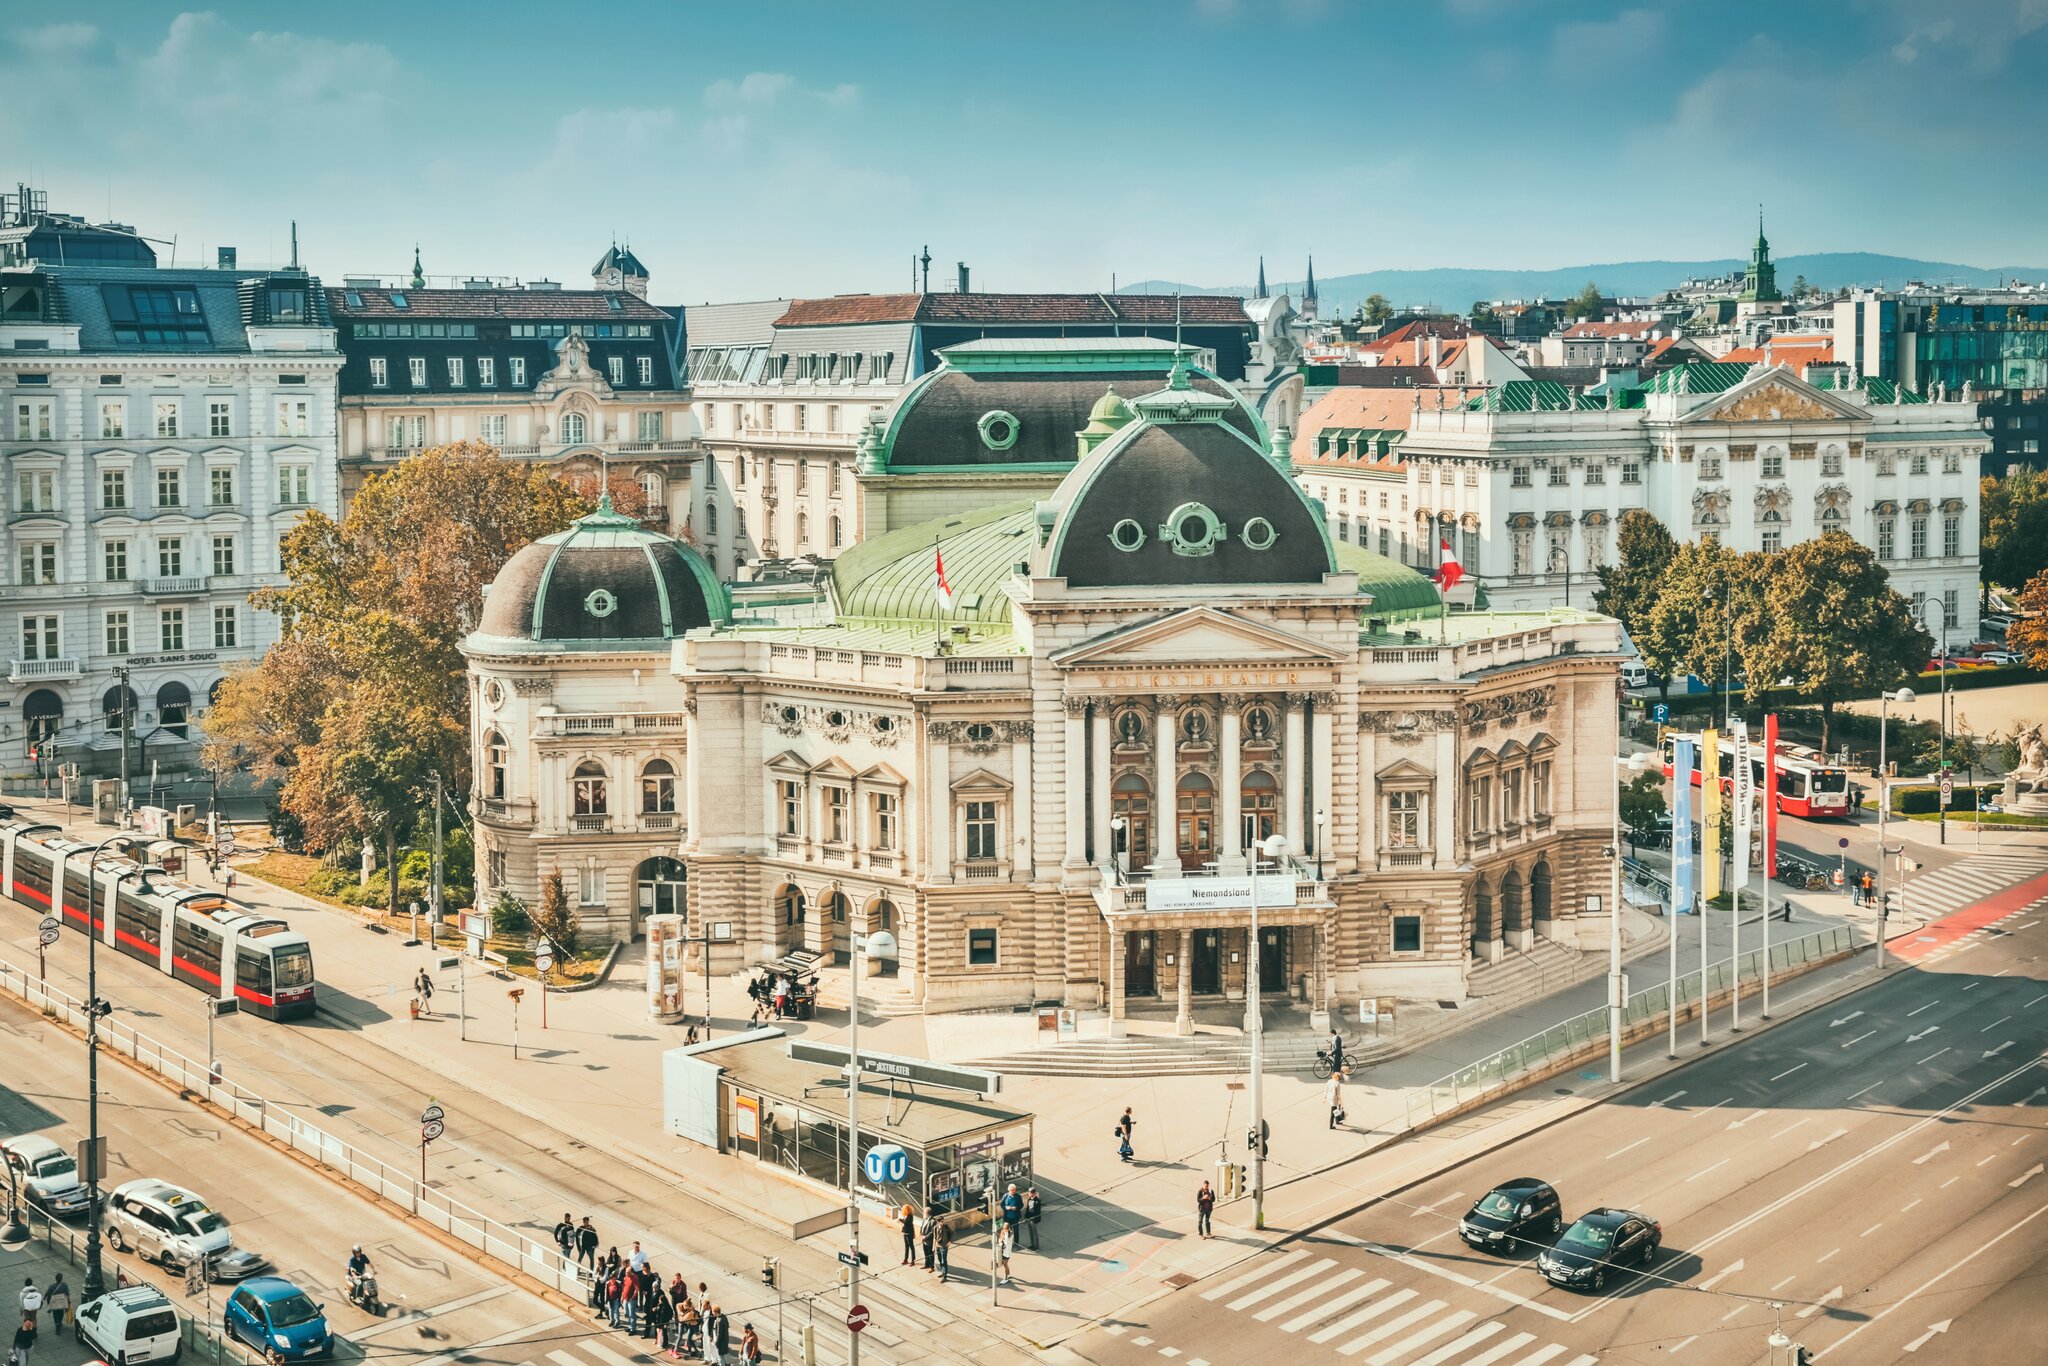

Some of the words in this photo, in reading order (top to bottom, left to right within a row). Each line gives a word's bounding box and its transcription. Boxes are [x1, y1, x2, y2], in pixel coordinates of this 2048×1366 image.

[127, 656, 157, 665] HOTEL
[160, 655, 185, 663] SANS
[189, 653, 217, 661] SOUCI
[1098, 672, 1299, 688] VOLKSTHEATER
[1192, 888, 1251, 898] Niemandsland
[867, 1156, 882, 1181] U
[890, 1156, 906, 1181] U
